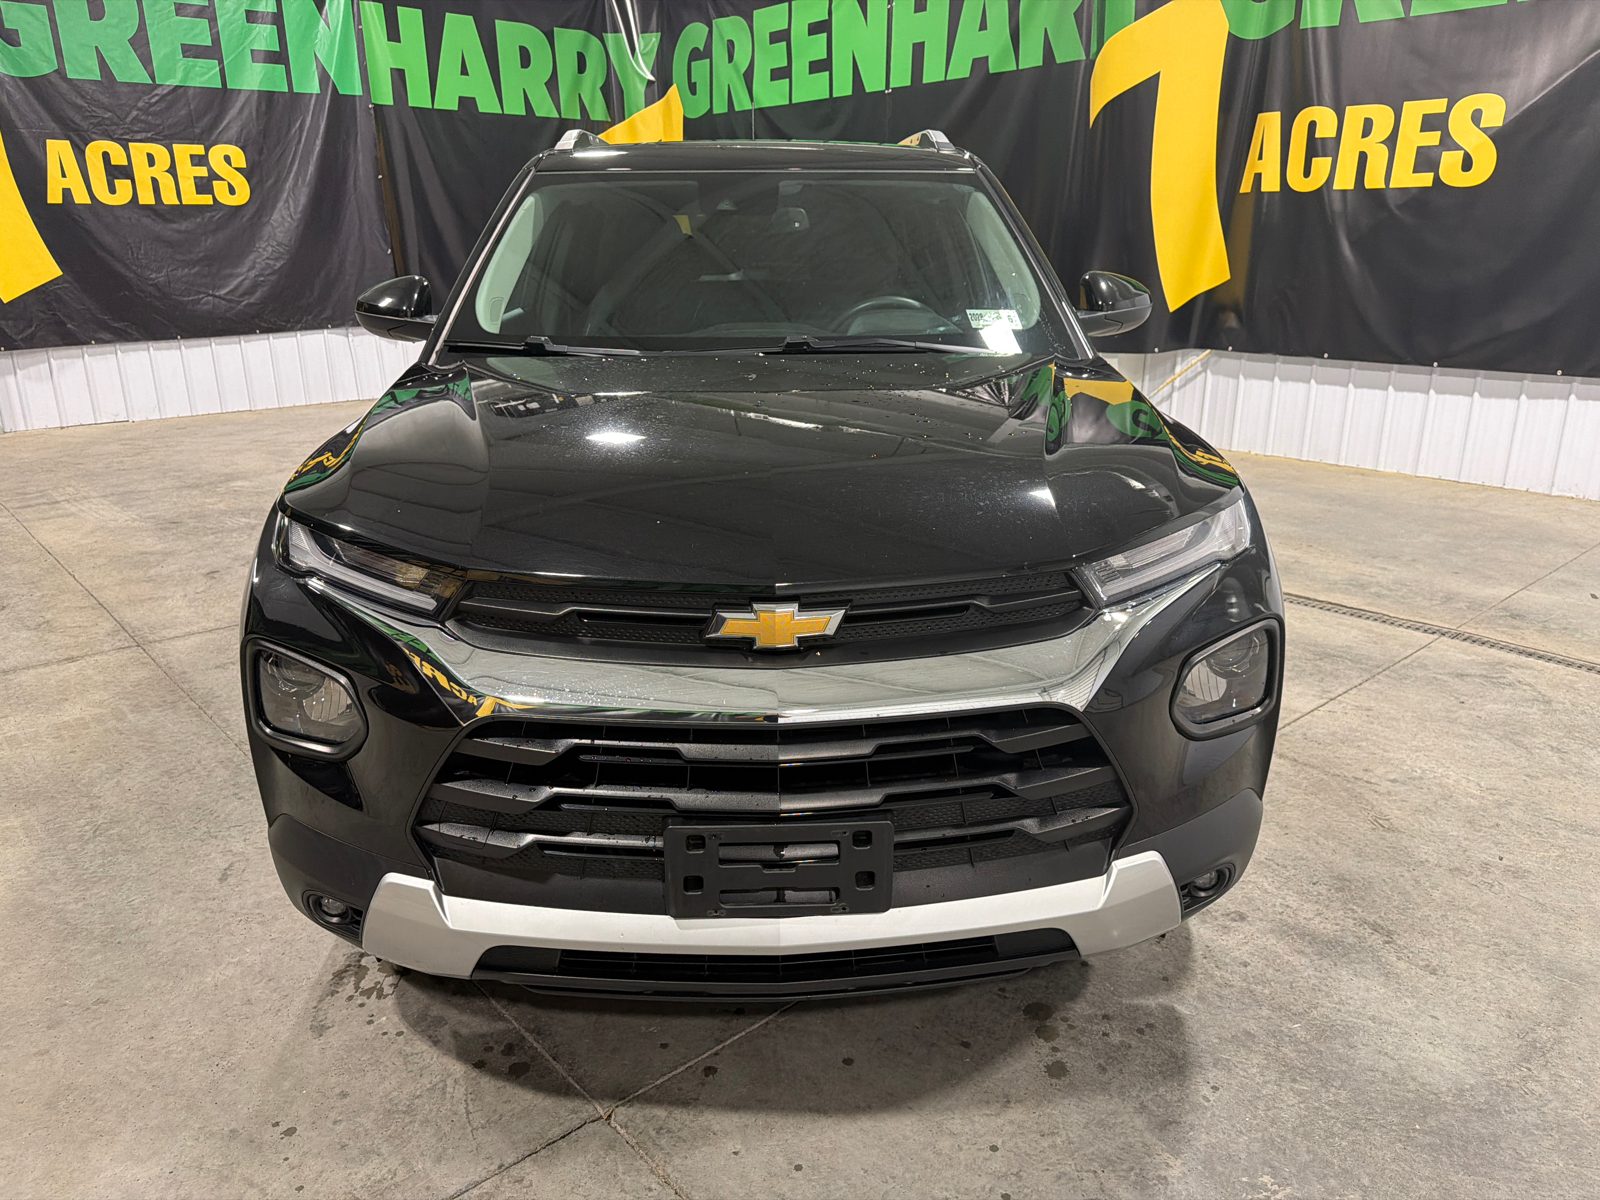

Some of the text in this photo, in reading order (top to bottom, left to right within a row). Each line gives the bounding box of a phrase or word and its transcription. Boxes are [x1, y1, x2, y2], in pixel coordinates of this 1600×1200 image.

[362, 2, 661, 121] HARRY
[672, 0, 889, 118] GREEN
[46, 138, 251, 206] ACRES
[1239, 92, 1507, 193] ACRES
